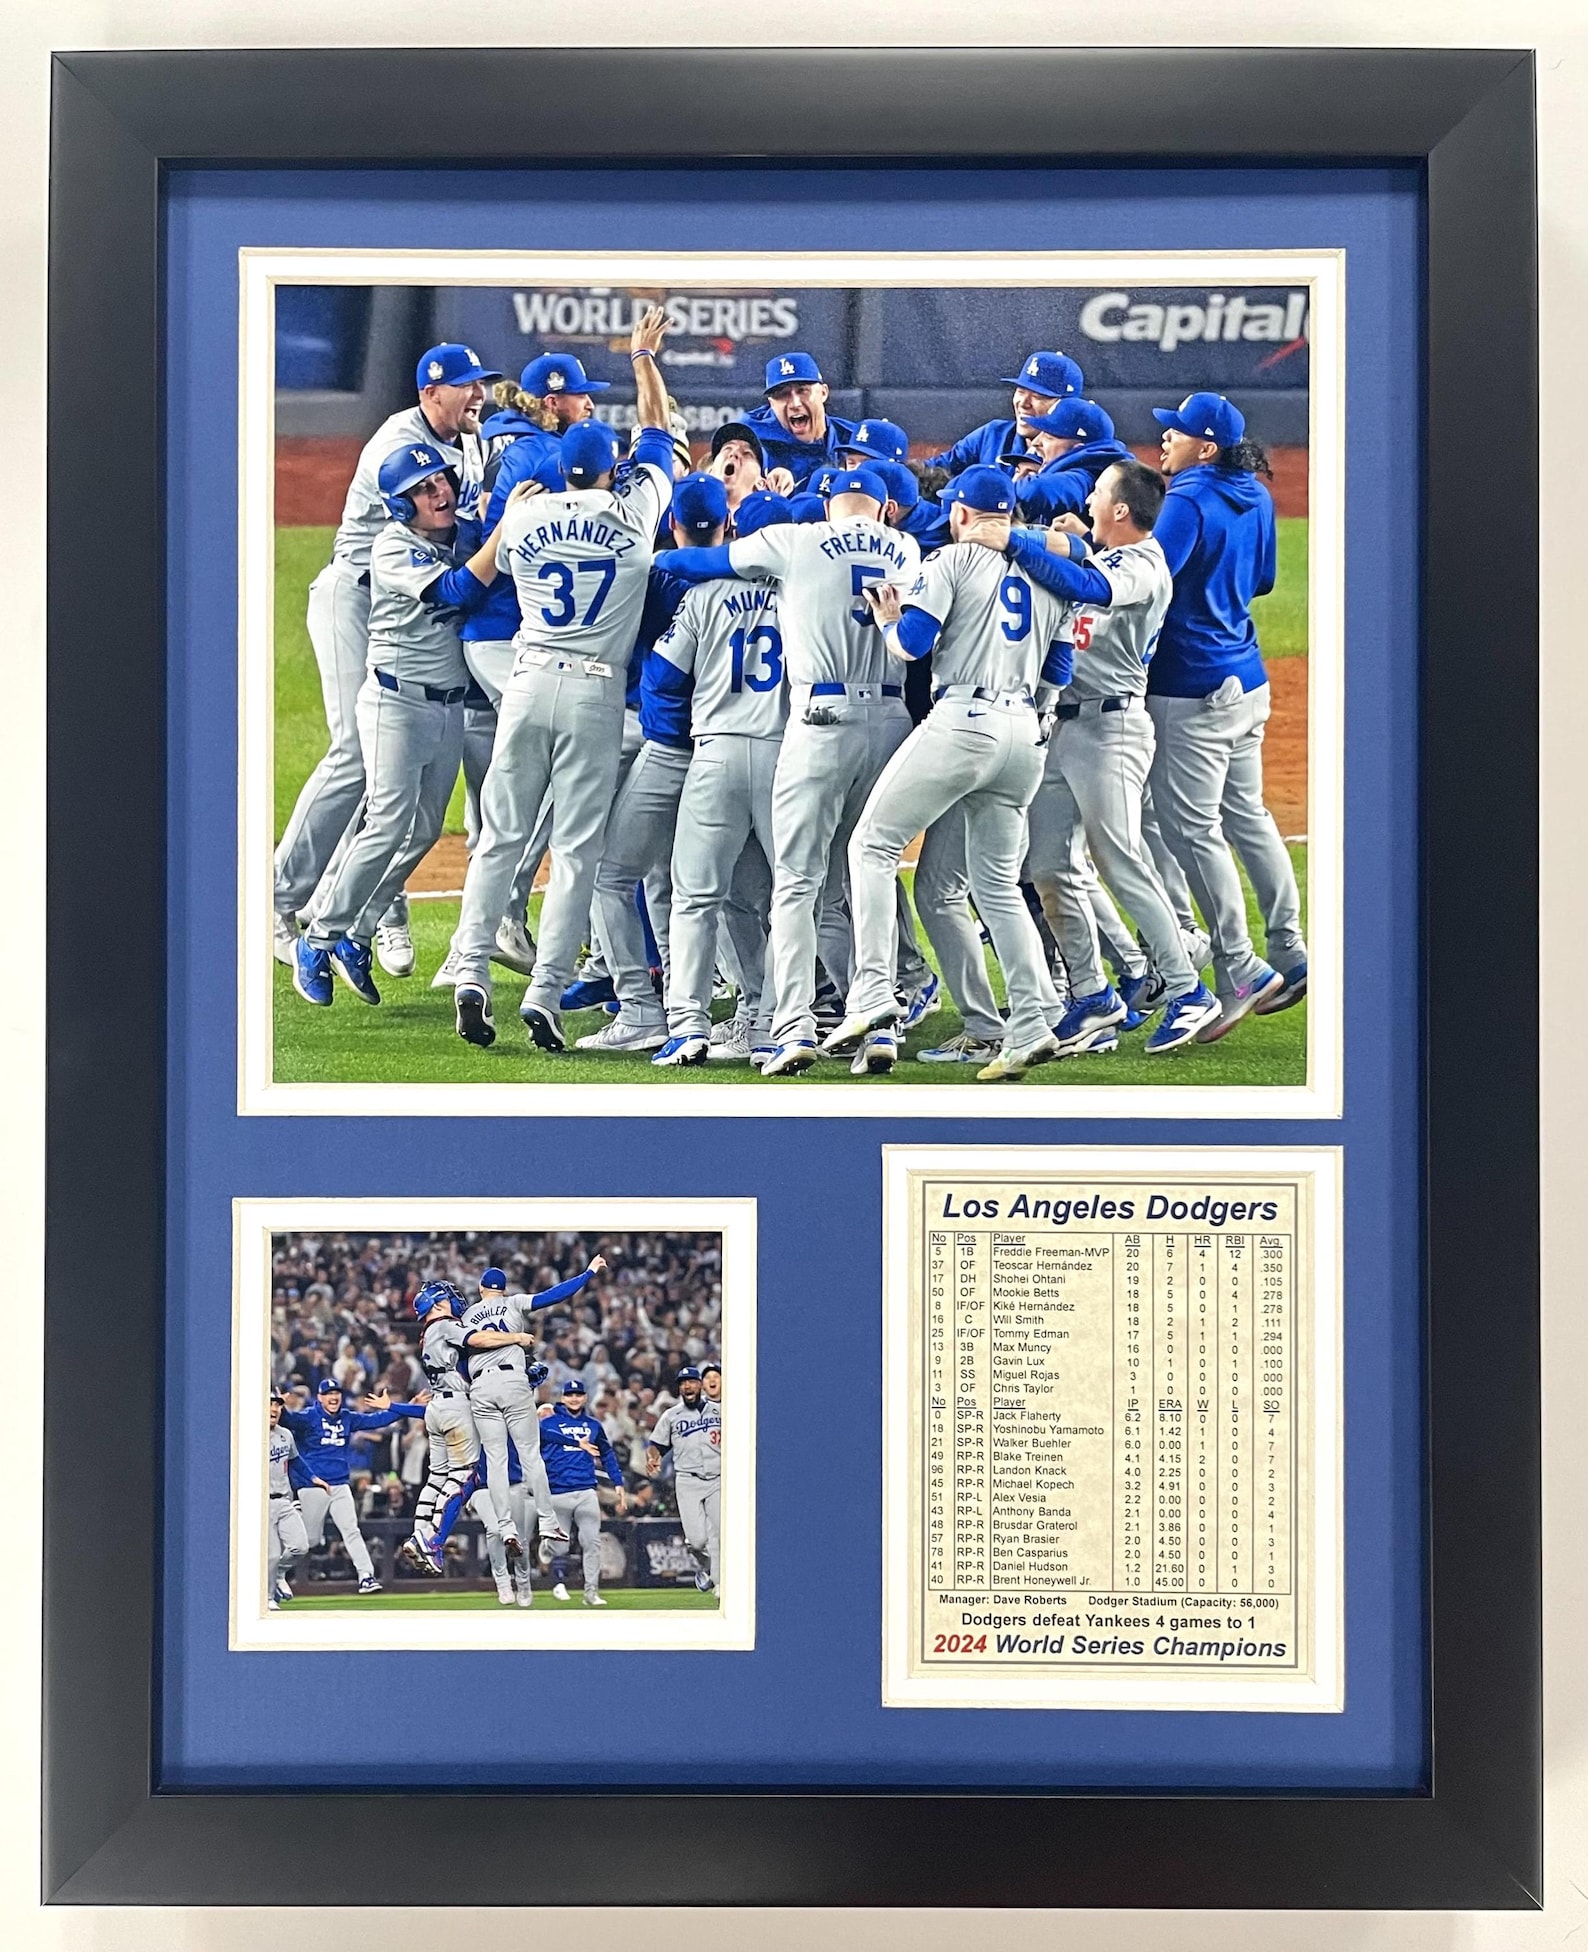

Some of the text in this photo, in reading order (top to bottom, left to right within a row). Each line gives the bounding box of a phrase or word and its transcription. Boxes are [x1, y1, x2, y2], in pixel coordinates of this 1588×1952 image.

[513, 293, 799, 340] WORLD SERIES
[515, 514, 637, 564] HERNÁNDEZ
[820, 532, 907, 571] FREEMAN
[538, 559, 616, 627] 37
[851, 565, 886, 627] 5
[723, 590, 778, 618] MUNC
[1000, 575, 1032, 642] 9
[729, 625, 784, 693] 13
[942, 1193, 1278, 1226] Los Angeles Dodgers
[931, 1233, 1283, 1247] No Pos Player AB HR RBI Avg.
[960, 1245, 1110, 1257] 1B Freddie Freeman-MVP
[932, 1260, 1093, 1271] 37 OF Teoscar Hernández
[932, 1273, 1066, 1284] 17 DH Shohei Ohtani
[932, 1287, 1060, 1298] 50 OF Mookie Betts
[956, 1300, 1075, 1312] IF/OF Kiké Hernández
[469, 1305, 508, 1326] BUEHLER
[932, 1314, 1044, 1325] 16 C Will Smith
[932, 1328, 1070, 1341] 25 IF/OF Tommy Edman
[932, 1342, 1052, 1355] 13 3B Max Muncy
[960, 1355, 1045, 1366] 2B Gavin Lux
[932, 1368, 1060, 1382] 11 SS Miguel Rojas
[960, 1382, 1054, 1396] OF Chris Taylor
[932, 1396, 1280, 1410] No Pos Player IP ERA SO
[956, 1409, 1062, 1423] SP-R Jack Flaherty
[932, 1423, 1105, 1435] 18 SP-R Yoshinobu Yamamoto
[931, 1437, 1072, 1448] 21 SP-R Walker Buehler
[931, 1450, 1064, 1462] 49 RP-R Blake Treinen
[931, 1464, 1067, 1476] 96 RP-R Landon Knack
[931, 1478, 1075, 1491] 45 RP-R Michael Kopech
[931, 1492, 1046, 1503] 51 RP-L Alex Vesia
[931, 1505, 1072, 1519] 43 RP-L Anthony Banda
[931, 1519, 1078, 1531] 48 RP-R Brusdar Graterol
[931, 1533, 1060, 1546] 57 RP-R Ryan Brasier
[931, 1547, 1068, 1560] 78 RP-R Ben Casparius
[931, 1560, 1068, 1572] 41 RP-R Daniel Hudson
[931, 1574, 1091, 1588] 40 RP-R Brent Honeywell Jr.
[939, 1594, 1067, 1607] Manager: Dave Roberts
[1088, 1595, 1279, 1610] Dodger Stadium (Capacity: 56,000)
[962, 1612, 1255, 1631] Dodgers defeat Yankees 4 games to 1
[933, 1634, 1287, 1661] 2024 World Series Champions
